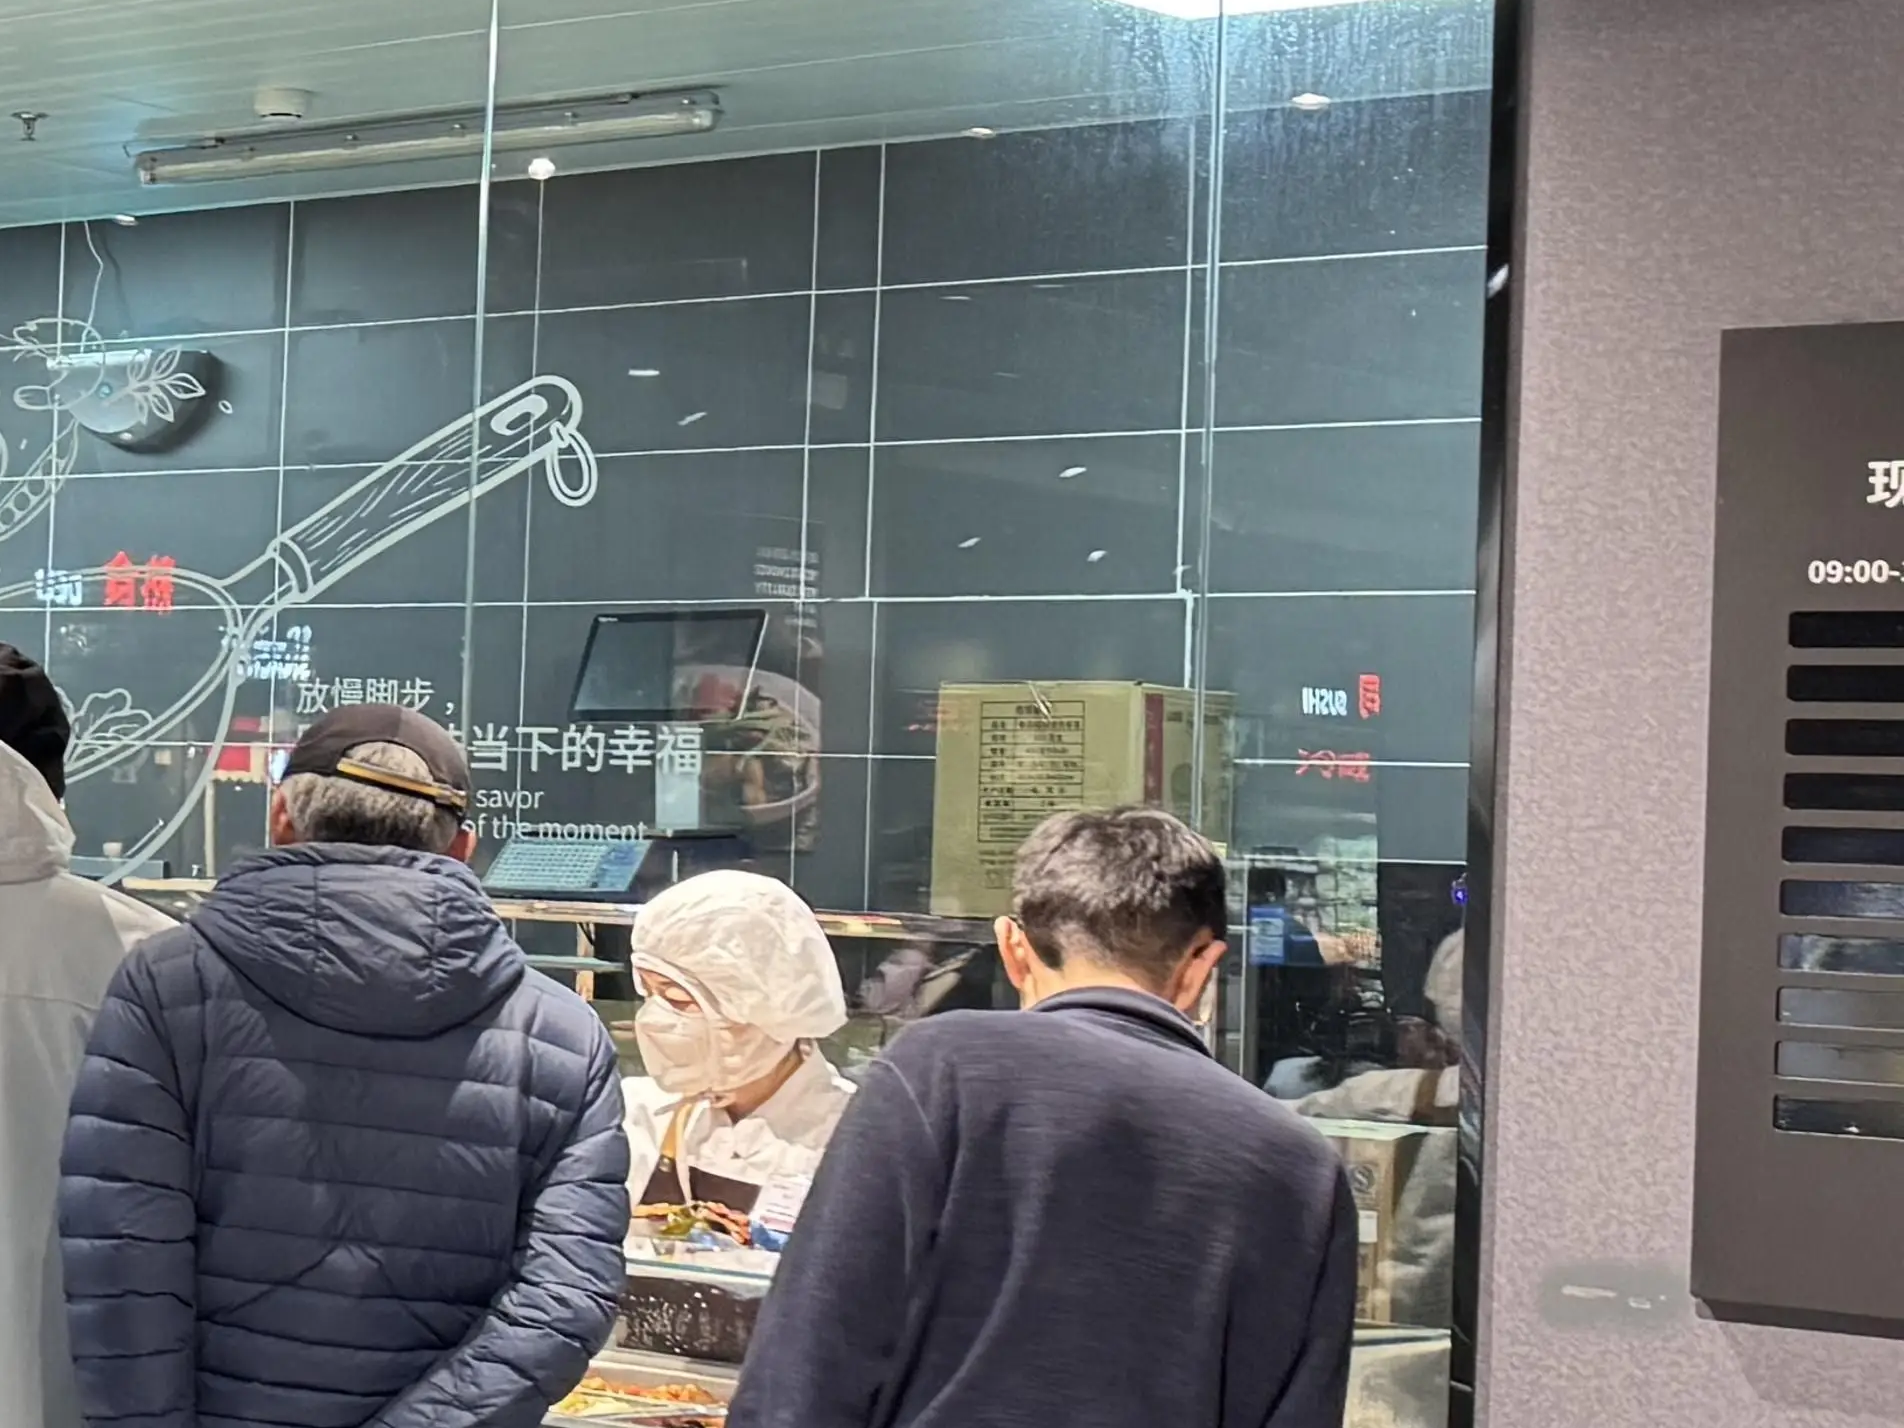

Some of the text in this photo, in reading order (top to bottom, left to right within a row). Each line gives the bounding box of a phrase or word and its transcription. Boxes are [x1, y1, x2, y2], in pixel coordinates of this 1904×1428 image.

[1808, 559, 1904, 584] 09:00-
[475, 787, 544, 810] savor
[462, 814, 647, 842] of the moment
